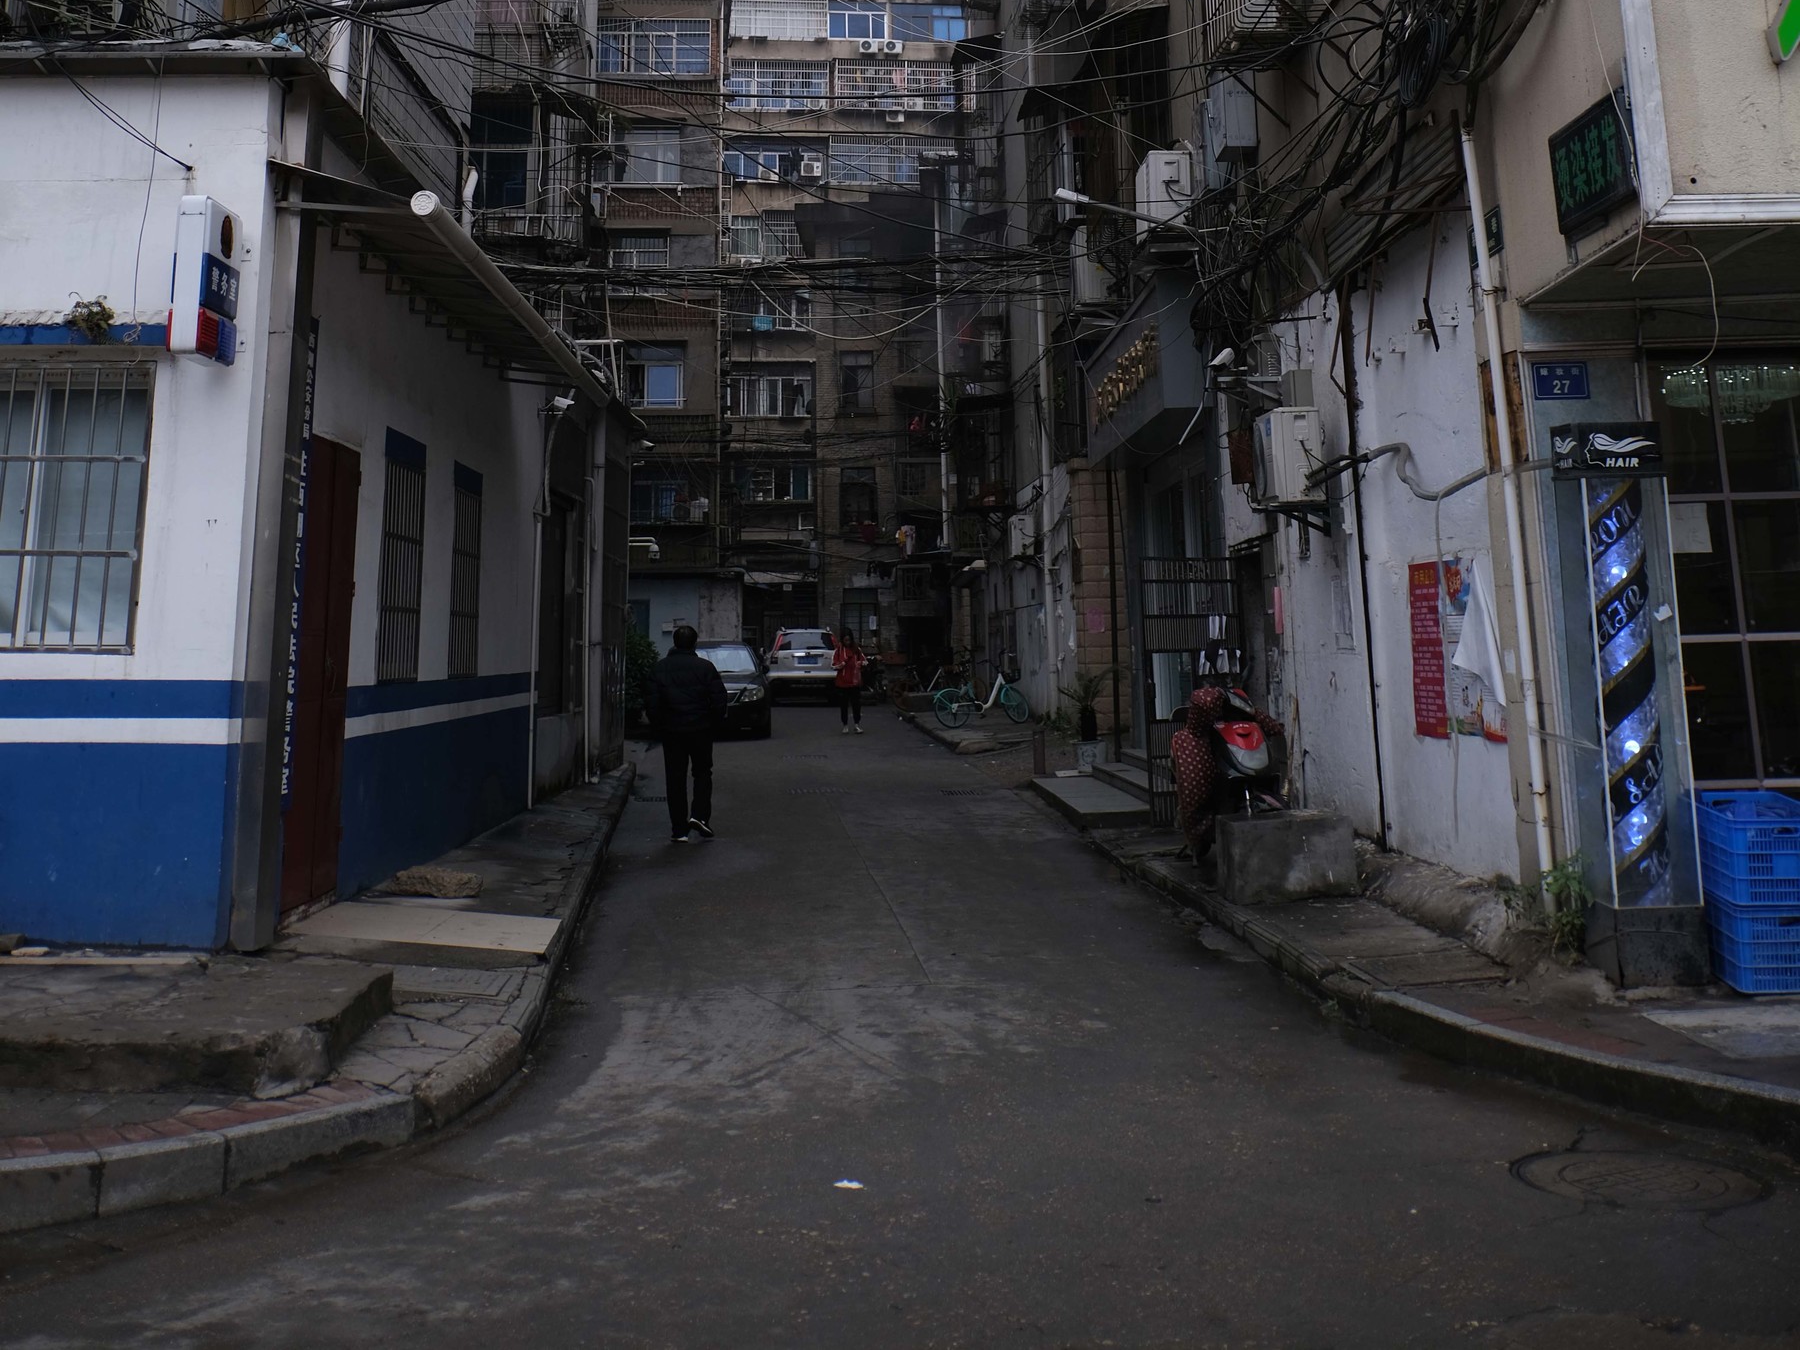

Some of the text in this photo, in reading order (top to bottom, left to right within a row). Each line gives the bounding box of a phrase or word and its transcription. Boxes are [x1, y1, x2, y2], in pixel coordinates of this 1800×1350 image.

[211, 266, 238, 302] 警务室
[1552, 379, 1571, 394] 27
[1605, 457, 1641, 468] HAIR
